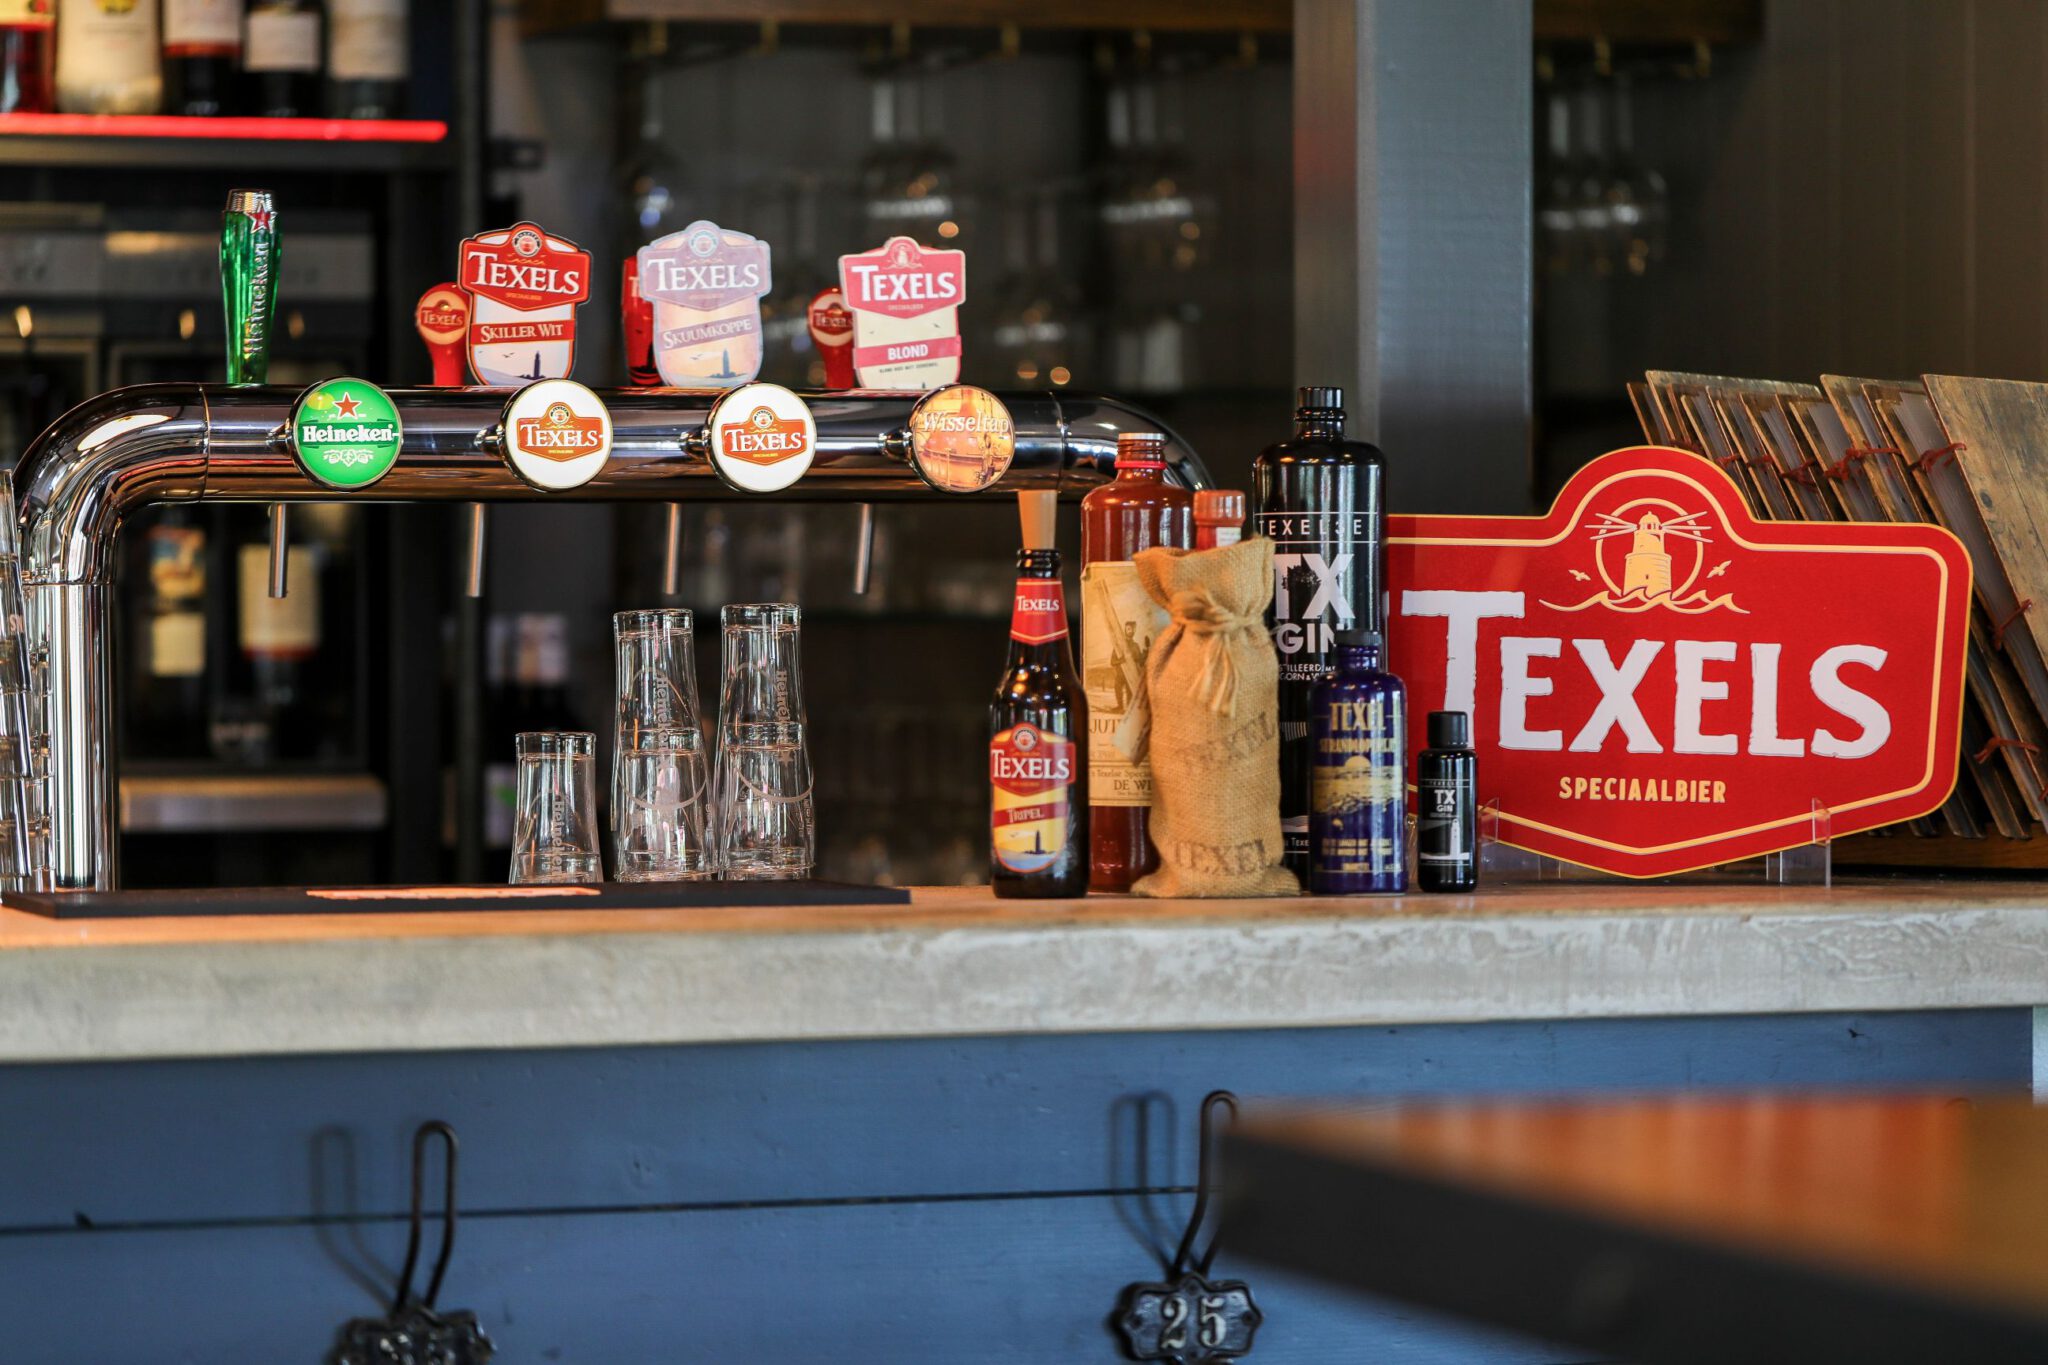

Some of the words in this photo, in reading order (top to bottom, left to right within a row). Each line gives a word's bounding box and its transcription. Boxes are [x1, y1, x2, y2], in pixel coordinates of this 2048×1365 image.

[468, 252, 580, 295] TEXELS
[648, 258, 760, 291] TEXELS
[851, 265, 957, 301] TEXELS
[248, 242, 269, 356] Heineken
[422, 310, 463, 326] TEXELS
[480, 325, 536, 342] SKILLER
[538, 324, 563, 338] WIT
[663, 319, 752, 349] SKUUMKOPPE
[887, 344, 929, 360] BLOND
[302, 424, 393, 442] Heineken
[923, 409, 1009, 435] Wisseltap
[520, 424, 598, 447] TEXELS
[725, 429, 802, 452] TEXELS
[1273, 553, 1356, 619] TX
[1016, 595, 1060, 611] TEXELS
[1276, 622, 1345, 654] GIN
[1401, 589, 1891, 759] TEXELS
[1089, 719, 1120, 734] JUT
[1329, 702, 1386, 731] TEXEL
[990, 749, 1070, 779] TEXELS
[1114, 780, 1130, 790] DE
[1134, 780, 1152, 790] WI
[1434, 789, 1456, 805] TX
[1559, 776, 1726, 803] SPECIAALBIER
[1006, 807, 1045, 823] TRIPEL
[1290, 837, 1309, 846] TEXE
[1160, 1295, 1227, 1349] 25
